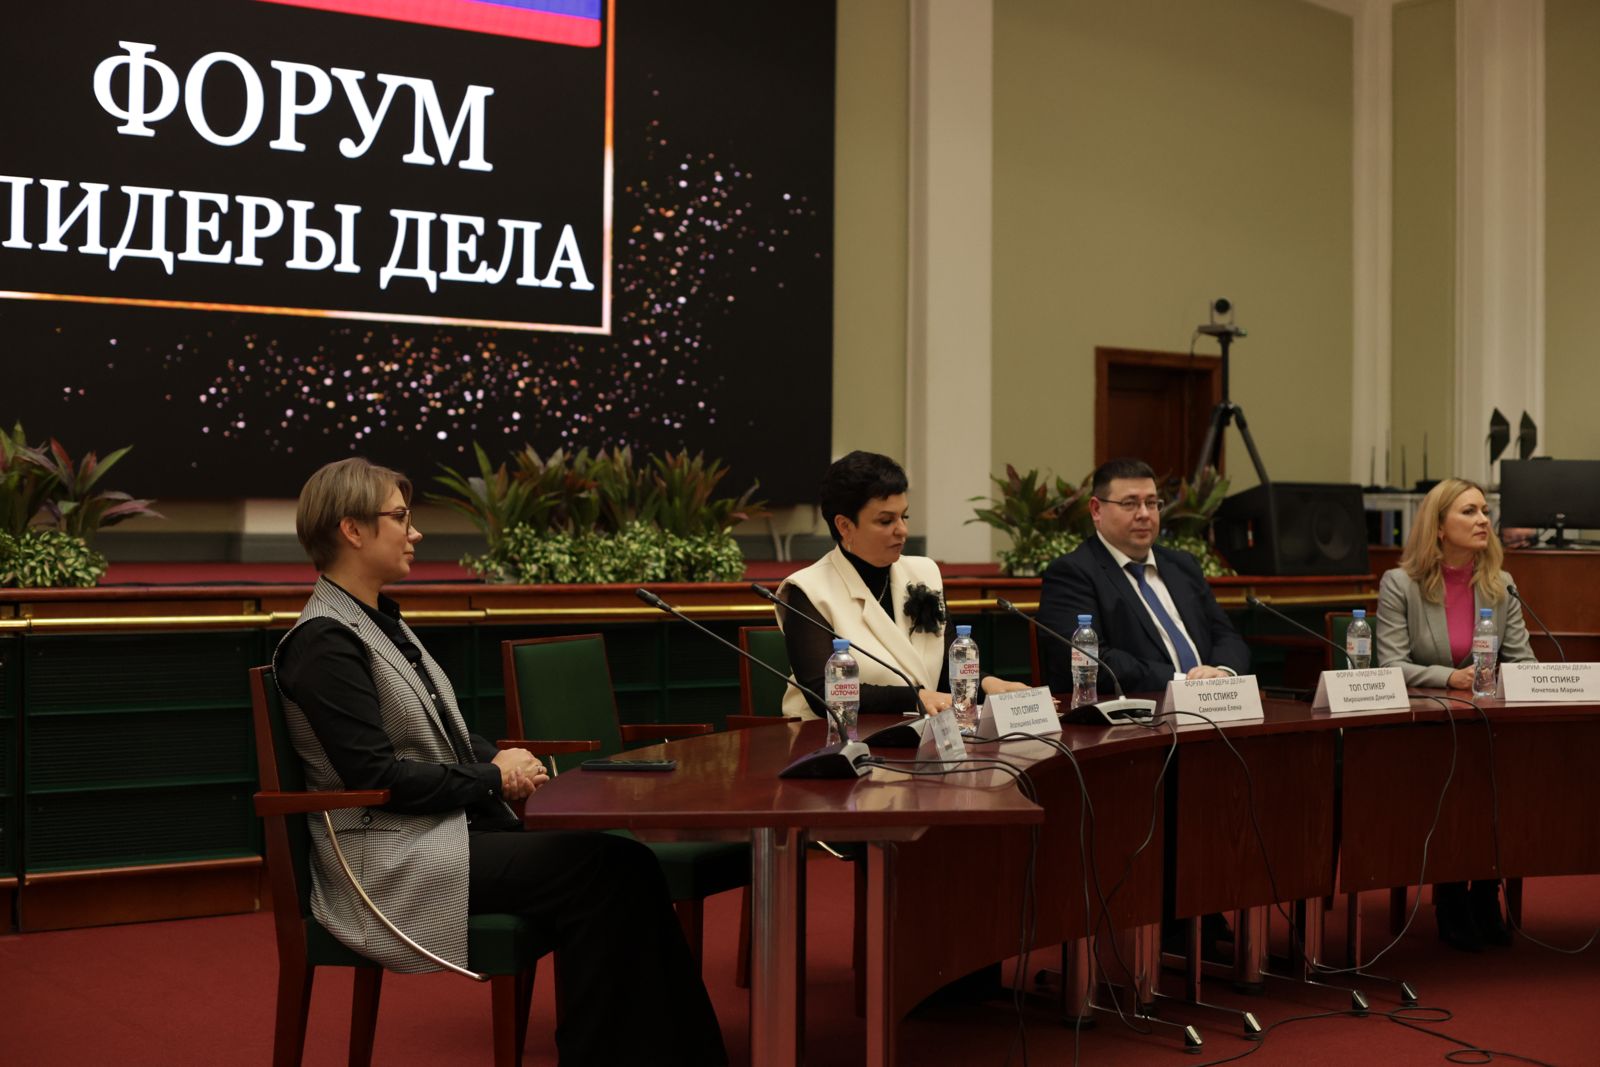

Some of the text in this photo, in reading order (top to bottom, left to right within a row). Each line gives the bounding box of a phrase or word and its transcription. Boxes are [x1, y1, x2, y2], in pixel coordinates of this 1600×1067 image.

[93, 40, 495, 172] ФОРУМ
[379, 208, 595, 293] ДЕЛА
[1532, 675, 1581, 684] ТОП СПИКЕР
[1349, 682, 1386, 692] ТОП СПИКЕР
[1198, 691, 1239, 702] ТОП СПИКЕР
[1010, 705, 1023, 717] ТОП
